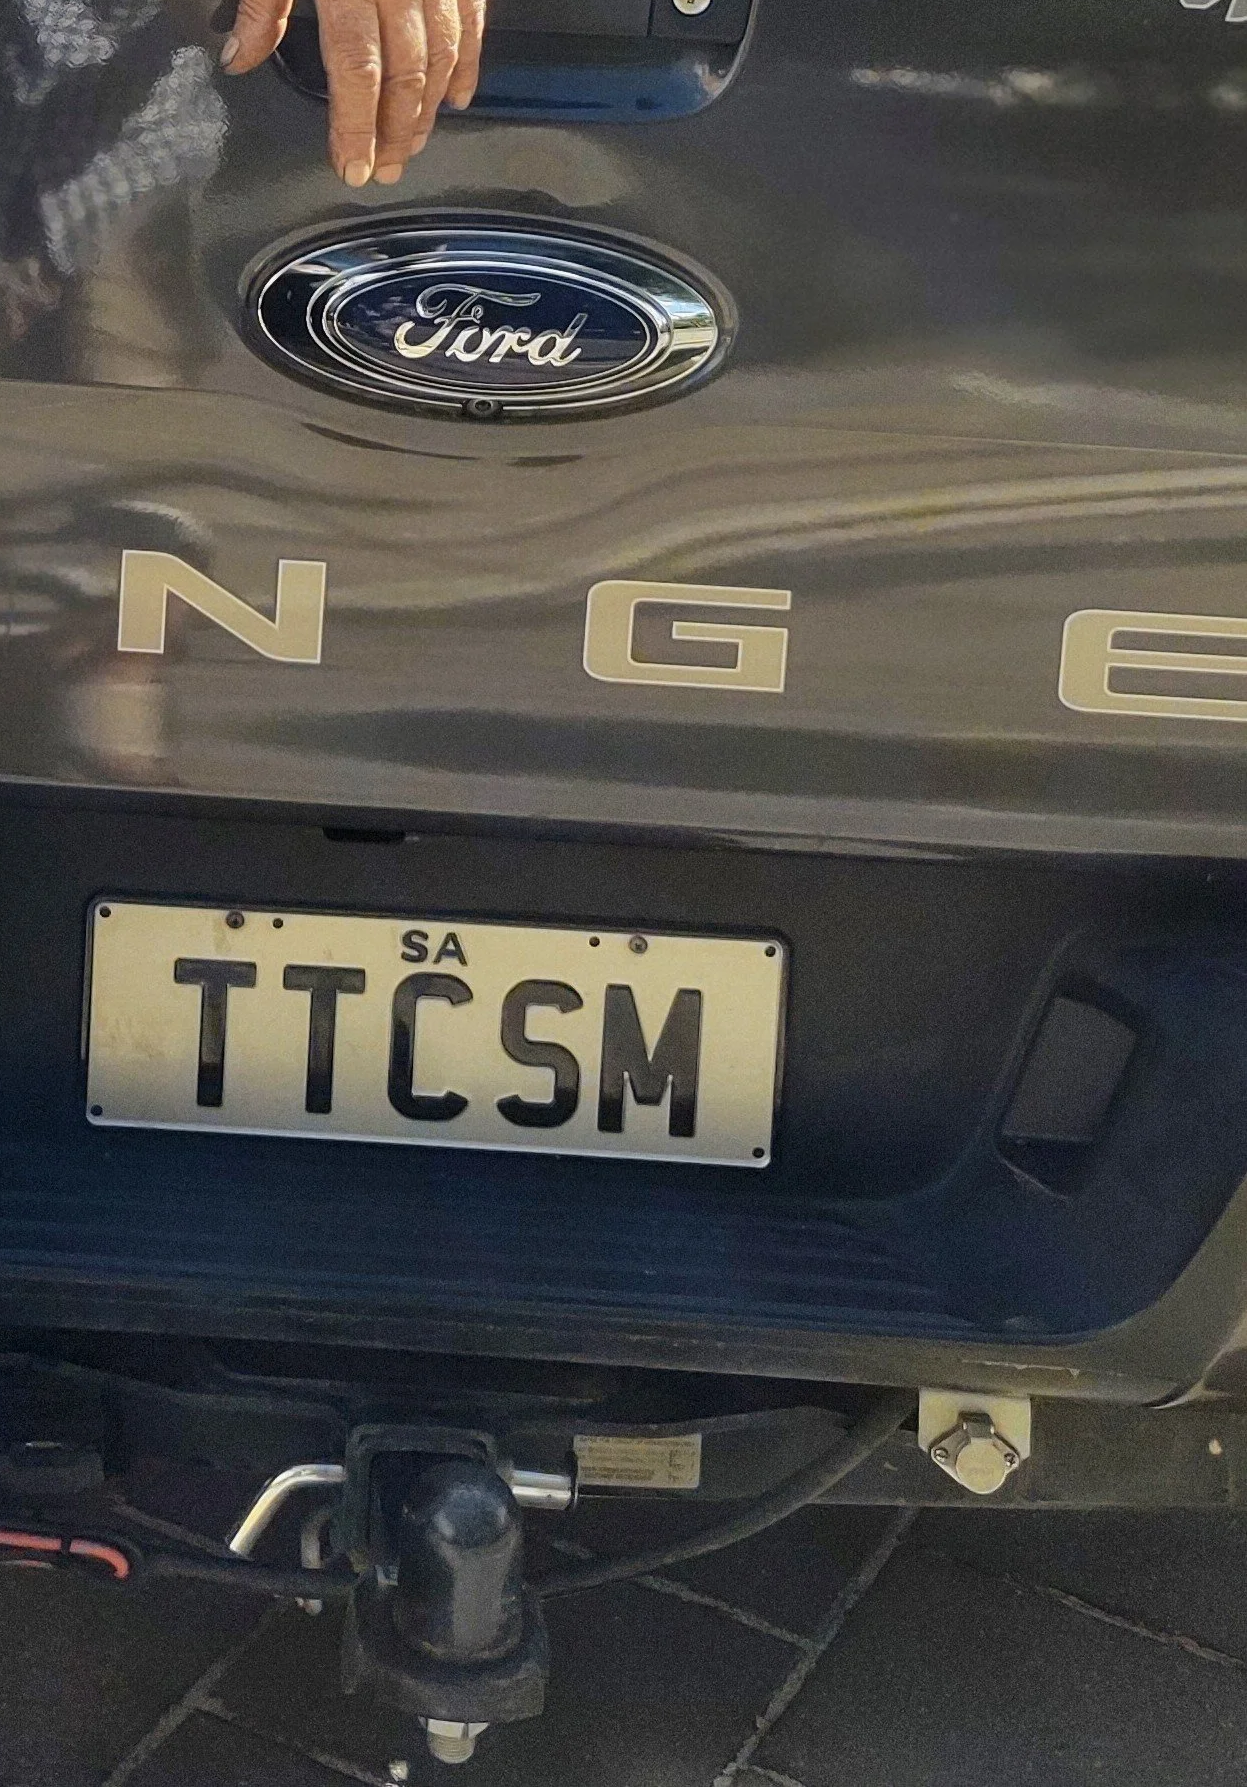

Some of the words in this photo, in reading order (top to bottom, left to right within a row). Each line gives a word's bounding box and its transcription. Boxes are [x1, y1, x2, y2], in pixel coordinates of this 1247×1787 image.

[394, 282, 586, 368] Ford
[400, 928, 469, 967] SA
[174, 957, 704, 1138] TTCSM
